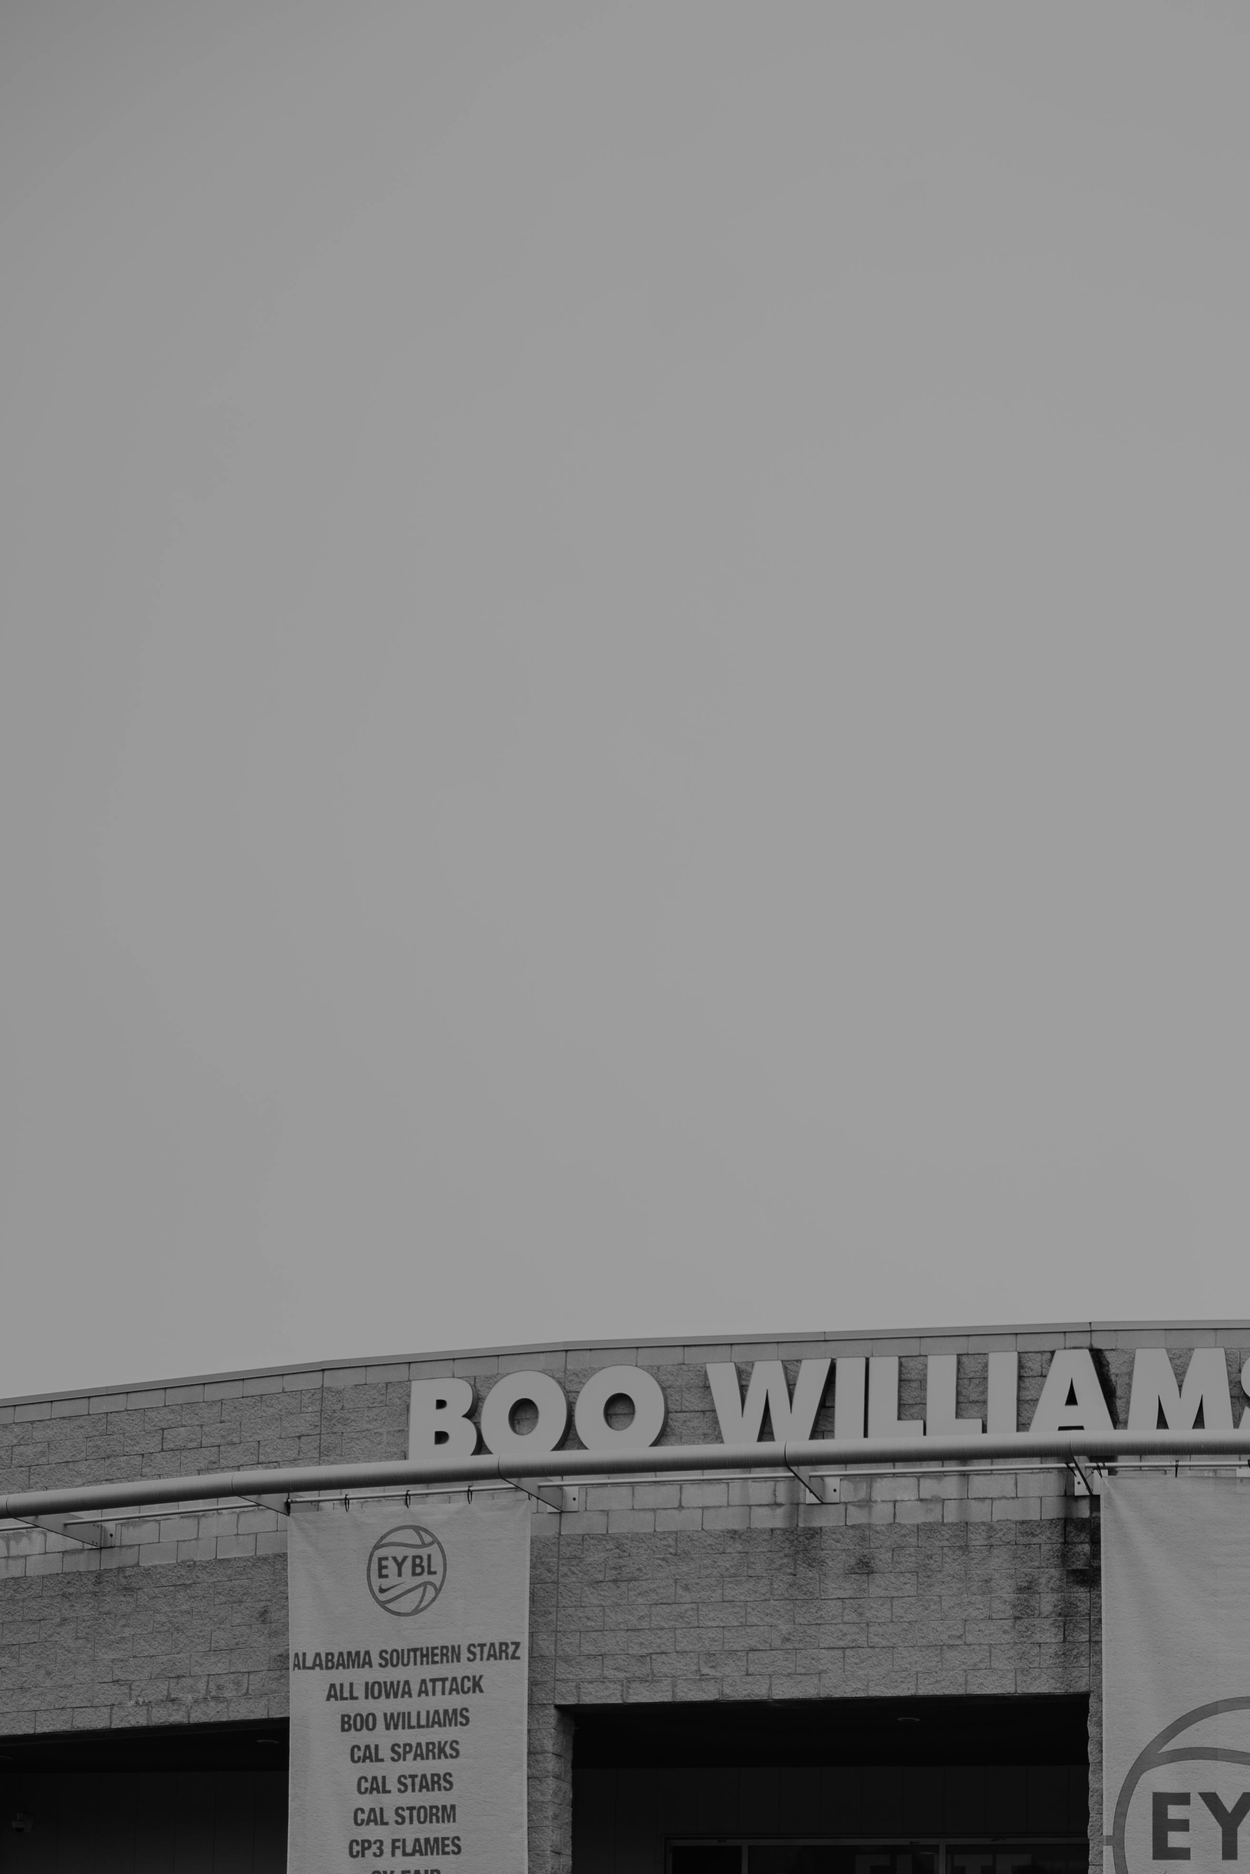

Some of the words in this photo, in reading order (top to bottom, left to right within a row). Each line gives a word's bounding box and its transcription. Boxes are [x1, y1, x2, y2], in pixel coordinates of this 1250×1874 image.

[409, 1366, 665, 1457] BOO
[378, 1554, 437, 1579] EYBL
[293, 1650, 373, 1671] ALABAMA
[379, 1645, 461, 1668] SOUTHERN
[467, 1642, 520, 1662] STARZ
[326, 1682, 358, 1701] ALL
[365, 1680, 412, 1699] IOWA
[418, 1675, 484, 1697] ATTACK
[341, 1713, 376, 1732] BOO
[384, 1708, 469, 1730] WILLIAMS
[350, 1744, 384, 1763] CAL
[390, 1740, 459, 1762] SPARKS
[357, 1776, 391, 1794] CAL
[398, 1772, 453, 1793] STARS
[354, 1807, 389, 1826] CAL
[395, 1804, 456, 1825] STORM
[349, 1839, 384, 1858] CP3
[391, 1836, 461, 1857] FLAMES
